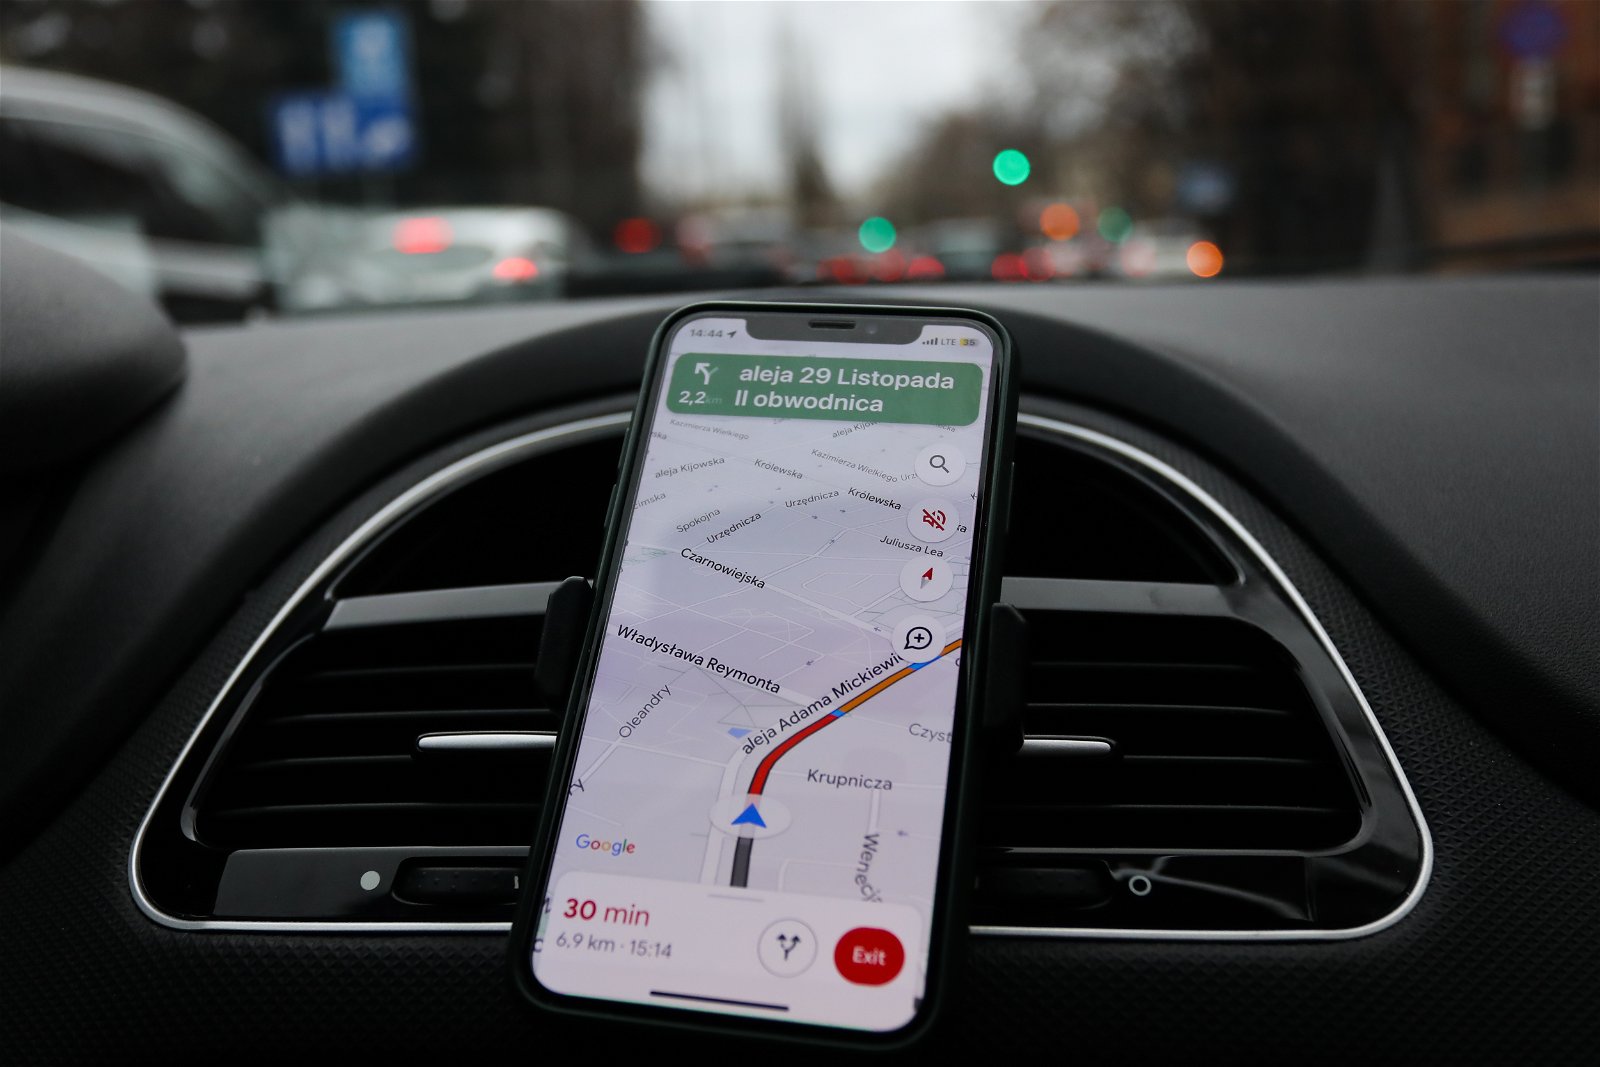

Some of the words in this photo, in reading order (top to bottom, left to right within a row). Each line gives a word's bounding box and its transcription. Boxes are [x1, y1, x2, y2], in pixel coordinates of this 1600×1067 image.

[689, 328, 723, 338] 14:44
[941, 338, 957, 346] LTE
[739, 365, 793, 385] aleja
[799, 367, 831, 385] 29
[837, 370, 955, 392] Listopada
[678, 390, 706, 406] 2,2
[754, 391, 884, 413] obwodnica
[669, 418, 711, 432] Kazimierza
[712, 426, 749, 440] Wielkiego
[832, 427, 853, 438] aleja
[655, 469, 679, 478] aleja
[680, 457, 725, 472] Kijowska
[754, 458, 803, 480] Królewska
[811, 448, 856, 469] Kazimierza
[857, 463, 898, 483] Wielkiego
[785, 490, 839, 508] Urzędnicza
[848, 487, 902, 510] Królewska
[676, 508, 721, 533] Spokojna
[706, 512, 762, 544] Urzędnicza
[879, 535, 922, 553] Juliusza
[924, 545, 944, 558] Lea
[680, 547, 766, 589] Czarnowiejska
[617, 624, 704, 666] Władysława
[706, 657, 780, 694] Reymonta
[618, 684, 672, 738] Oleandry
[742, 727, 778, 755] aleja
[778, 695, 832, 731] Adama
[807, 768, 893, 792] Krupnicza
[575, 833, 636, 857] Google
[563, 898, 597, 921] 30
[603, 904, 650, 927] min
[587, 934, 616, 953] km
[630, 940, 672, 959] 15:14
[852, 946, 887, 966] Exit
